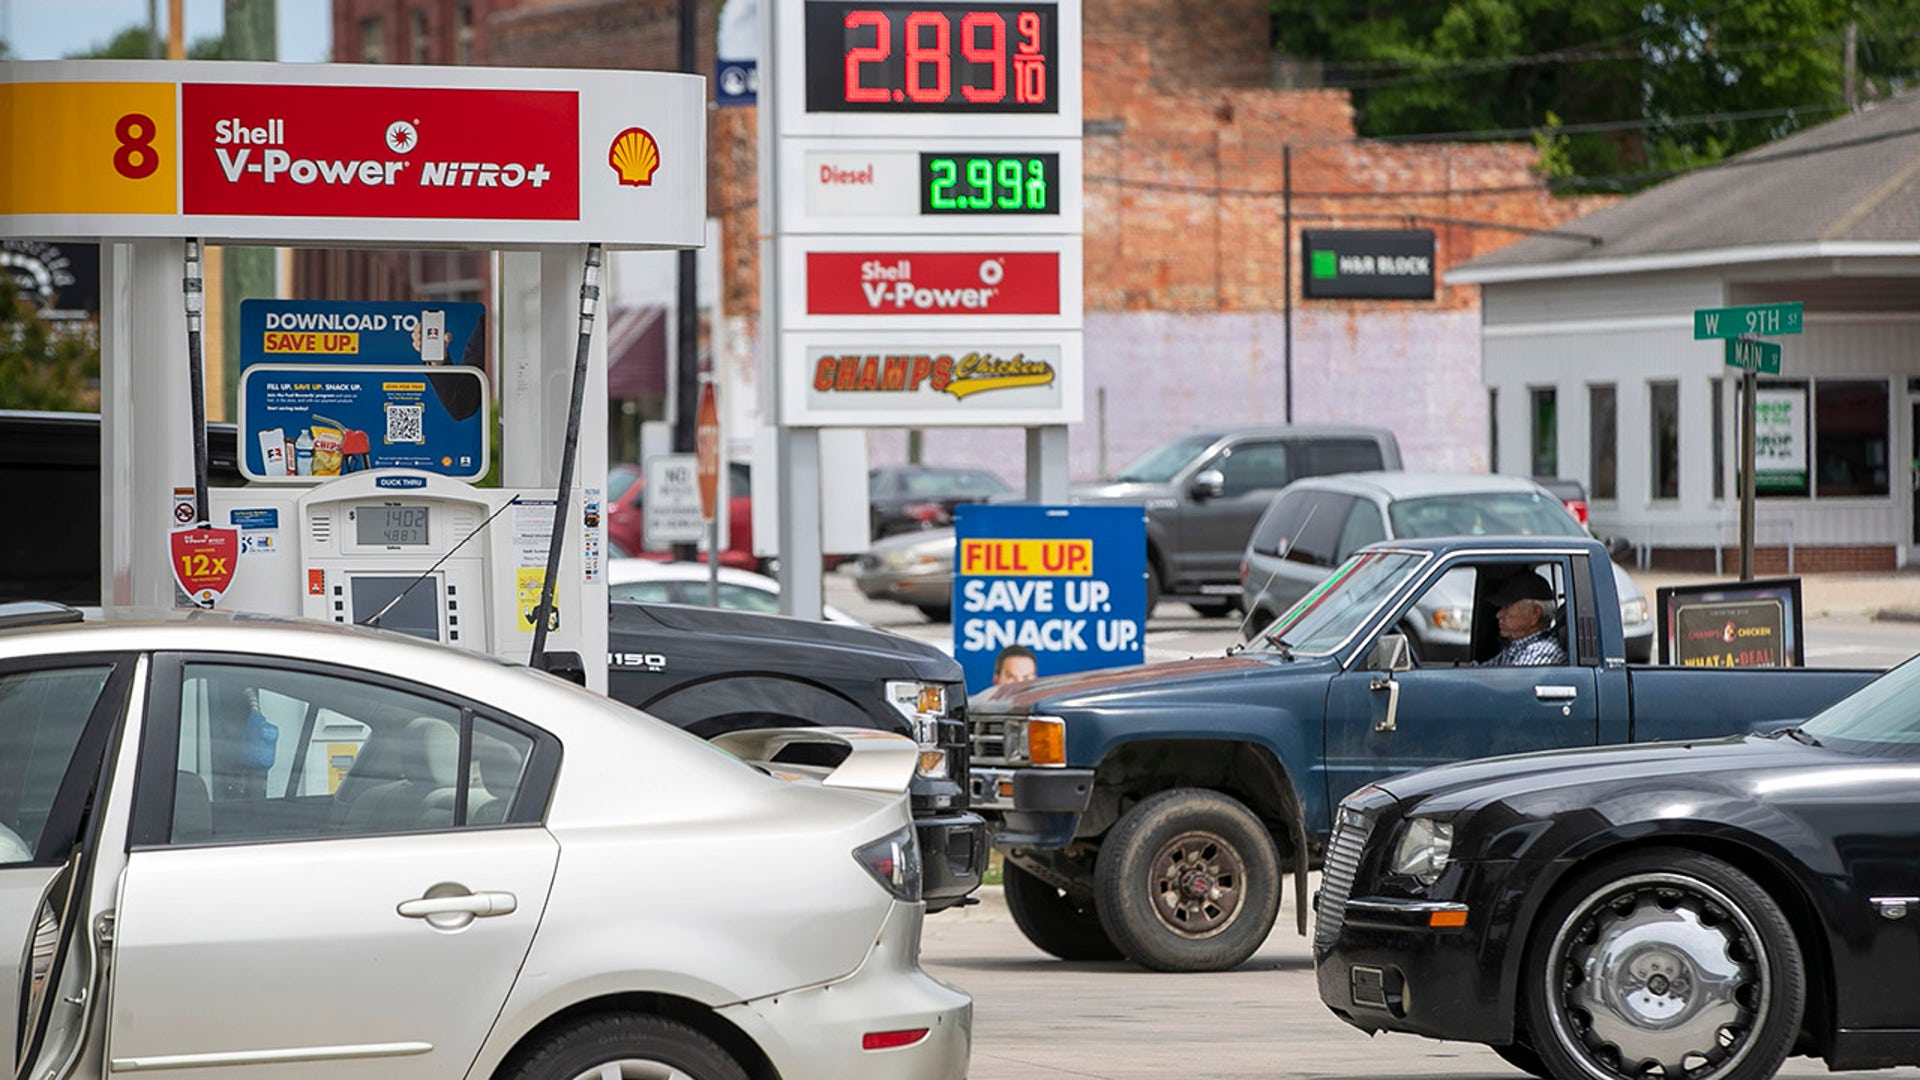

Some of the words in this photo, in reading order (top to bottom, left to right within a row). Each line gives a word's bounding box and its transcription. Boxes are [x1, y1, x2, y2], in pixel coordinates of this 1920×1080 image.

[844, 11, 1007, 103] 2.89
[215, 118, 284, 145] Shell
[113, 114, 159, 180] 8
[215, 148, 404, 186] V-Power
[820, 164, 873, 185] Diesel
[930, 159, 1023, 210] 2.99
[861, 260, 911, 281] Shell
[861, 282, 993, 309] V-Power
[266, 313, 388, 331] DOWNLOAD
[392, 315, 420, 332] TO
[1704, 312, 1719, 336] W
[1745, 308, 1780, 333] 9TH
[266, 333, 317, 351] SAVE
[323, 334, 356, 352] UP.
[1734, 341, 1763, 369] MAIN
[813, 354, 955, 392] CHAMPS
[954, 351, 1051, 379] Chicken
[182, 554, 228, 577] 12x
[966, 543, 1028, 571] FILL
[1042, 543, 1088, 571] UP.
[963, 580, 1054, 612] SAVE
[1064, 580, 1112, 612] UP.
[963, 619, 1088, 651] SNACK
[1096, 619, 1139, 651] UP.
[1737, 626, 1771, 638] CHICKEN
